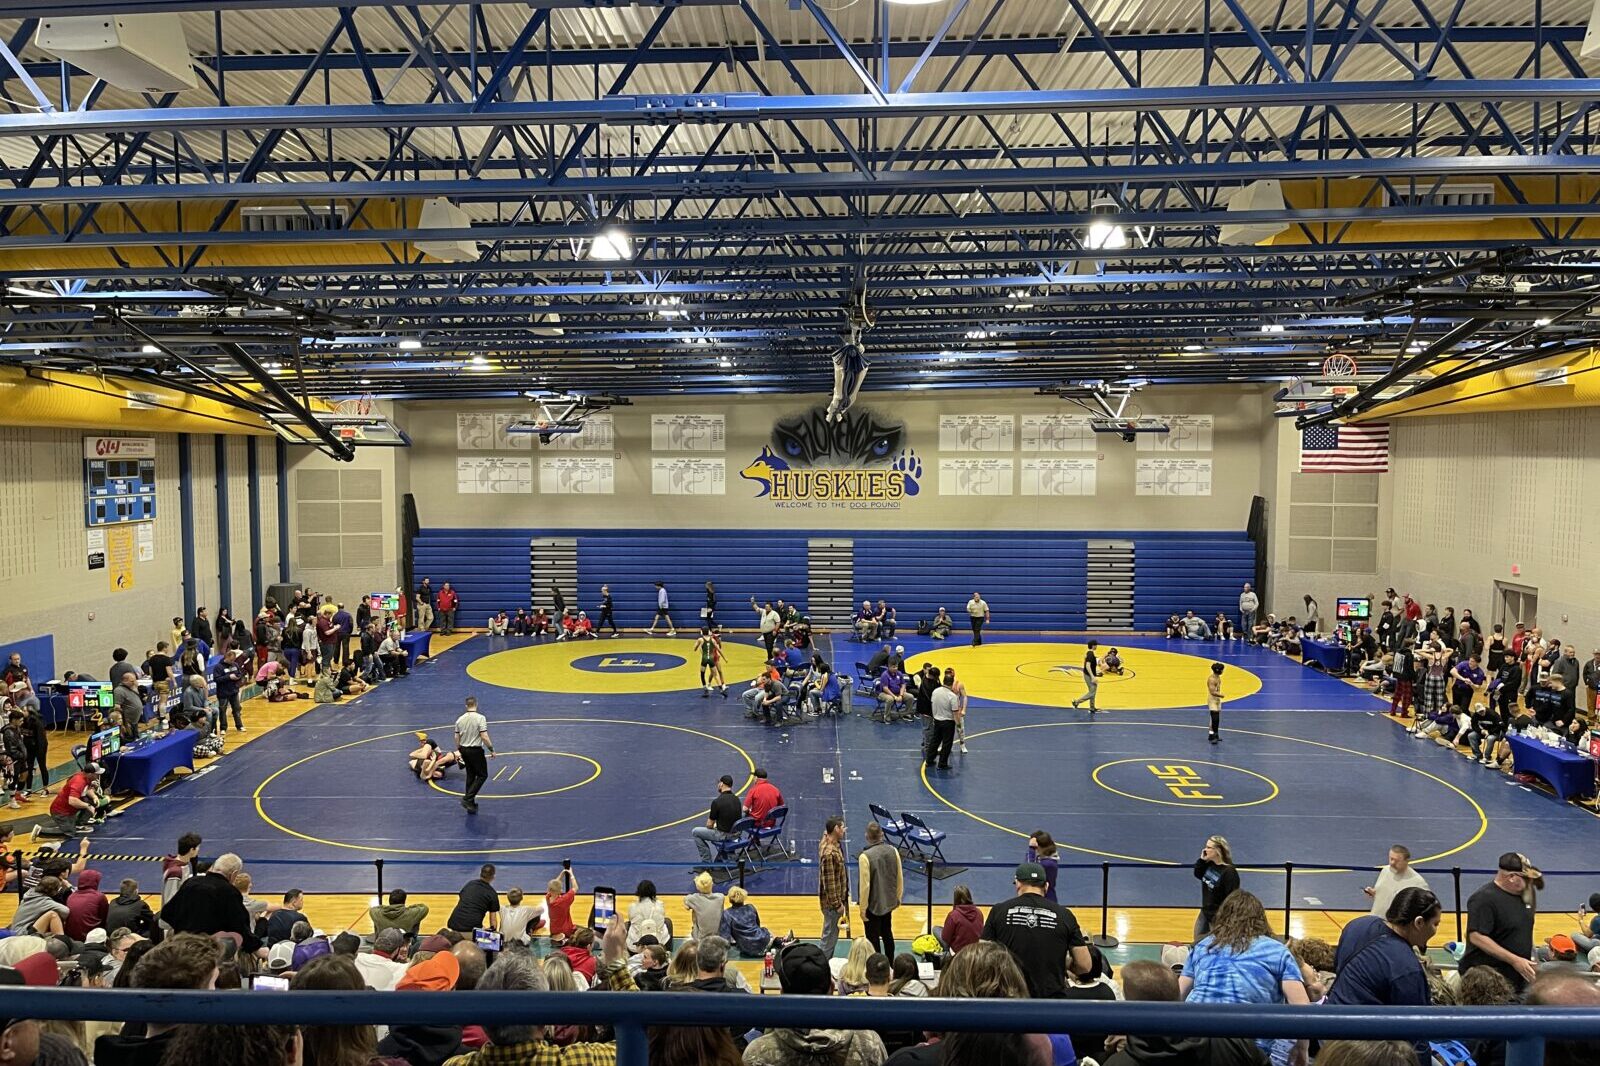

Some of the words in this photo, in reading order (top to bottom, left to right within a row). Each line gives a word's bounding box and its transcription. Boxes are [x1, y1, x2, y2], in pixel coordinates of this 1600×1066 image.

[770, 470, 904, 500] HUSKIES
[72, 695, 80, 704] 4
[102, 697, 111, 706] 0
[1146, 765, 1224, 799] FHS
